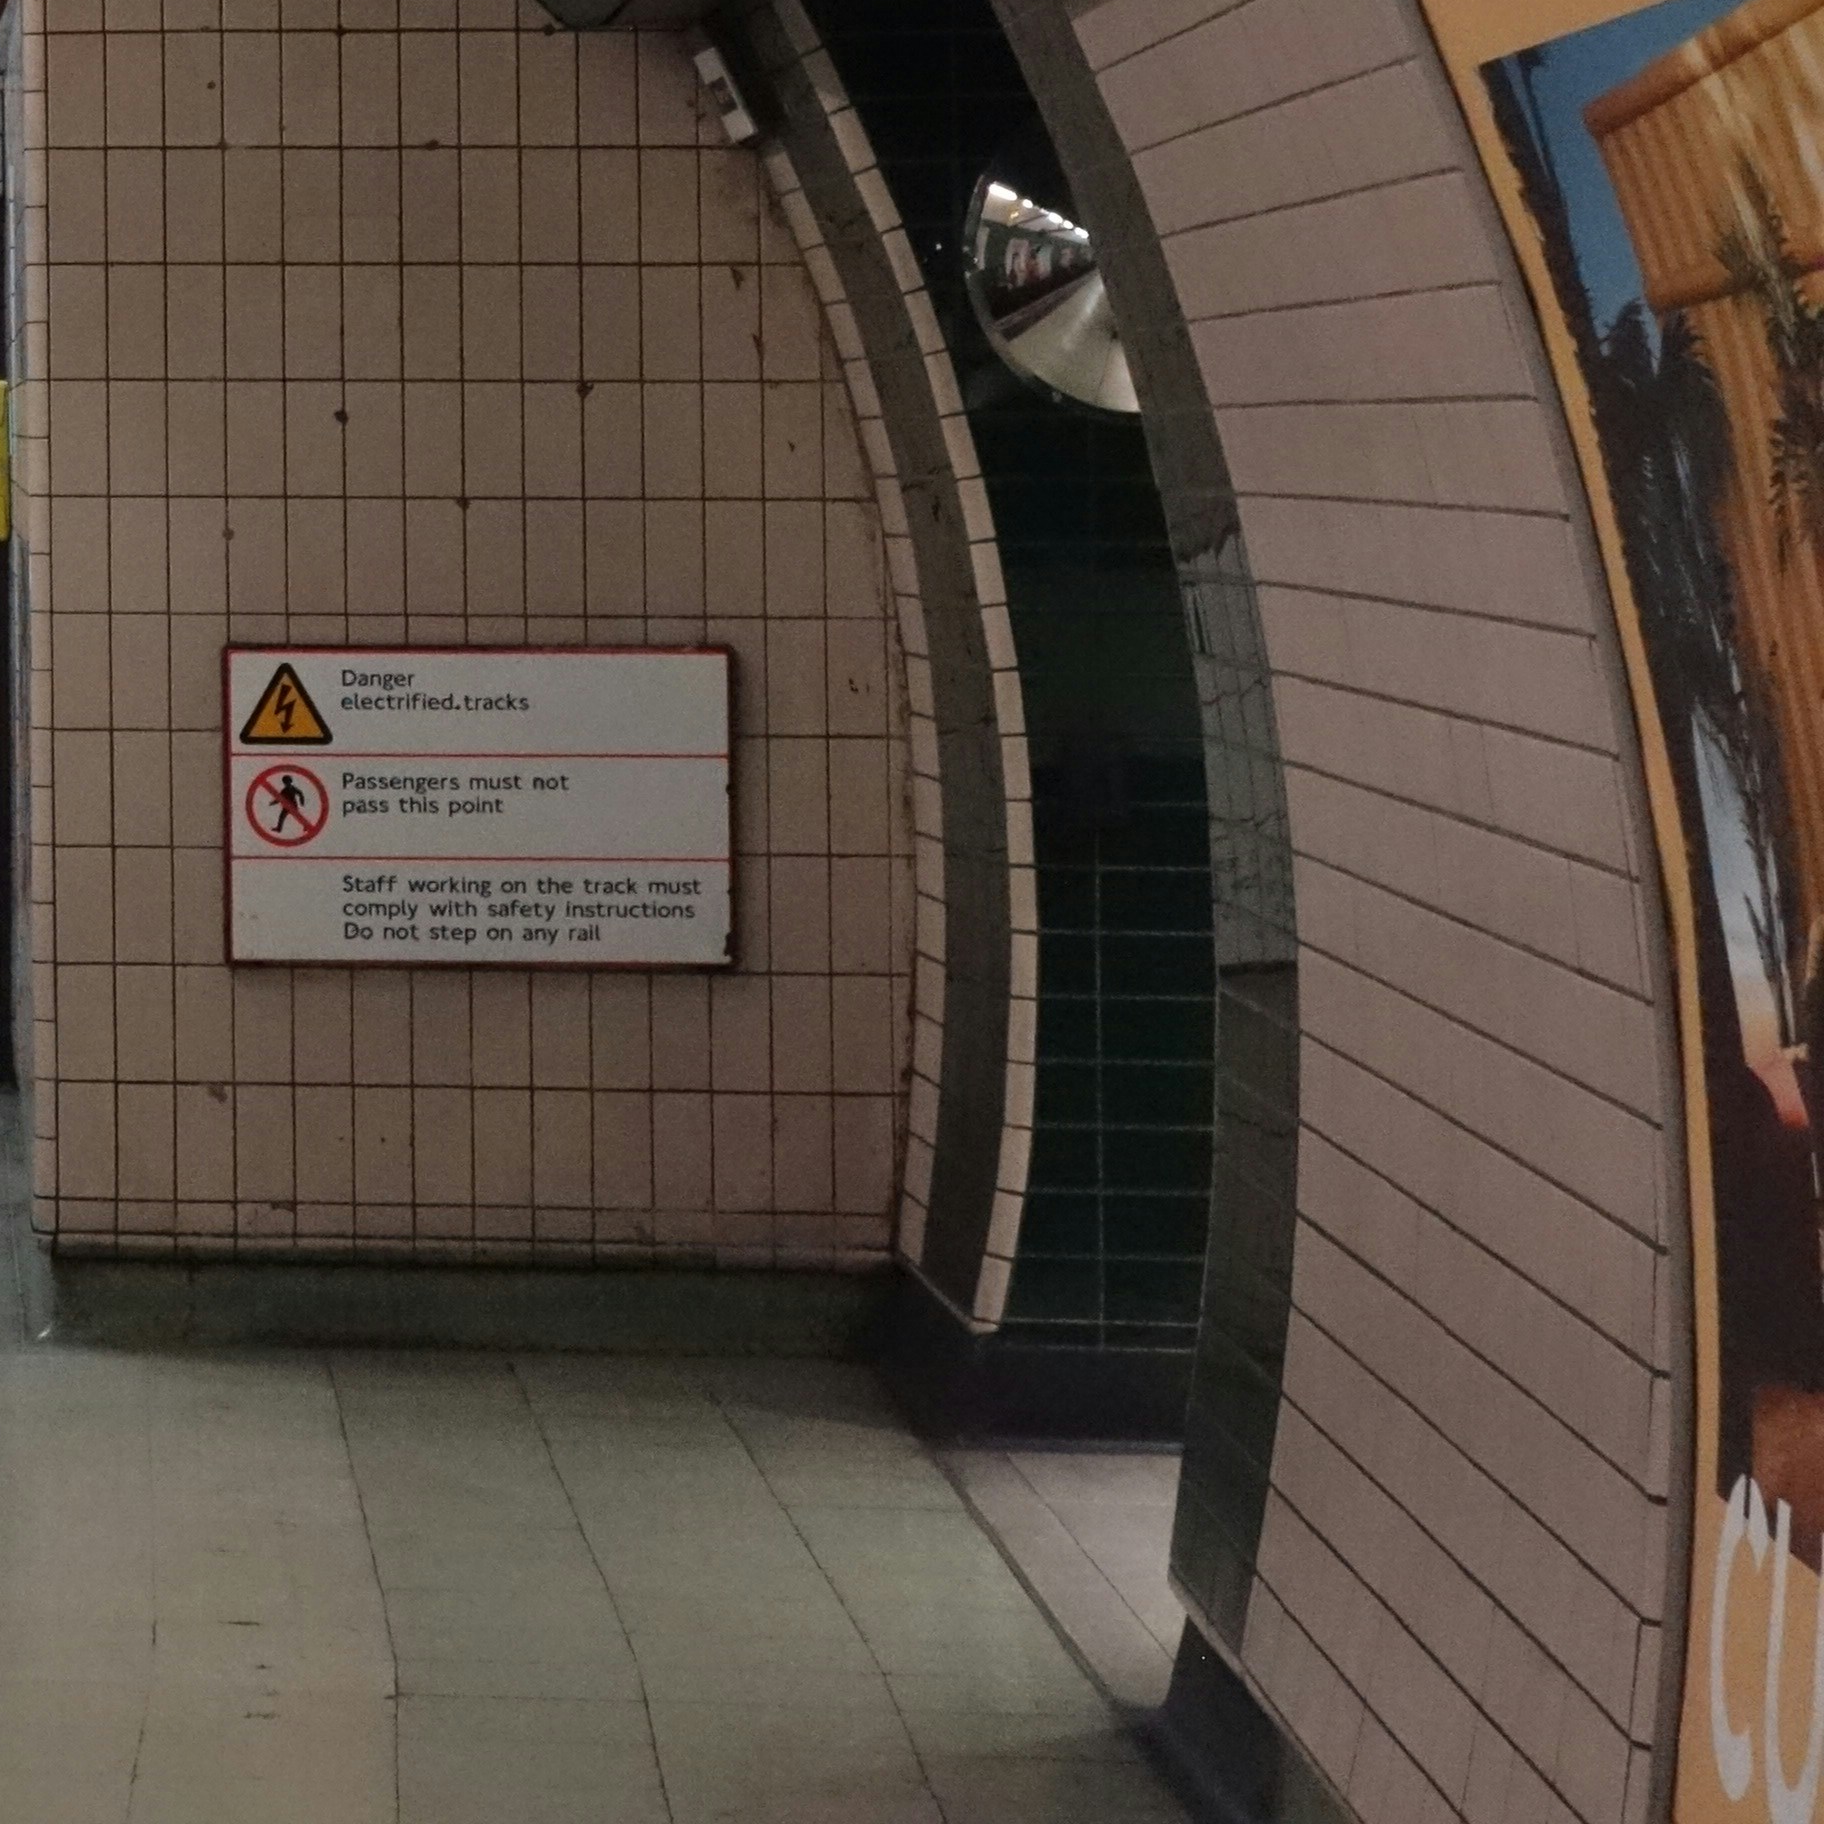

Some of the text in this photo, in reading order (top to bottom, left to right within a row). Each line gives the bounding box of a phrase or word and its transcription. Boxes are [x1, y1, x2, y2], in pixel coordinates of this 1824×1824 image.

[343, 670, 415, 688] Danger
[463, 694, 530, 711] tracks
[342, 773, 570, 794] Passengers must not
[342, 797, 505, 817] pass this point
[342, 875, 702, 897] Staff working on the track must
[342, 899, 696, 922] comply with safety instructions
[344, 921, 601, 945] Do not step on any rail
